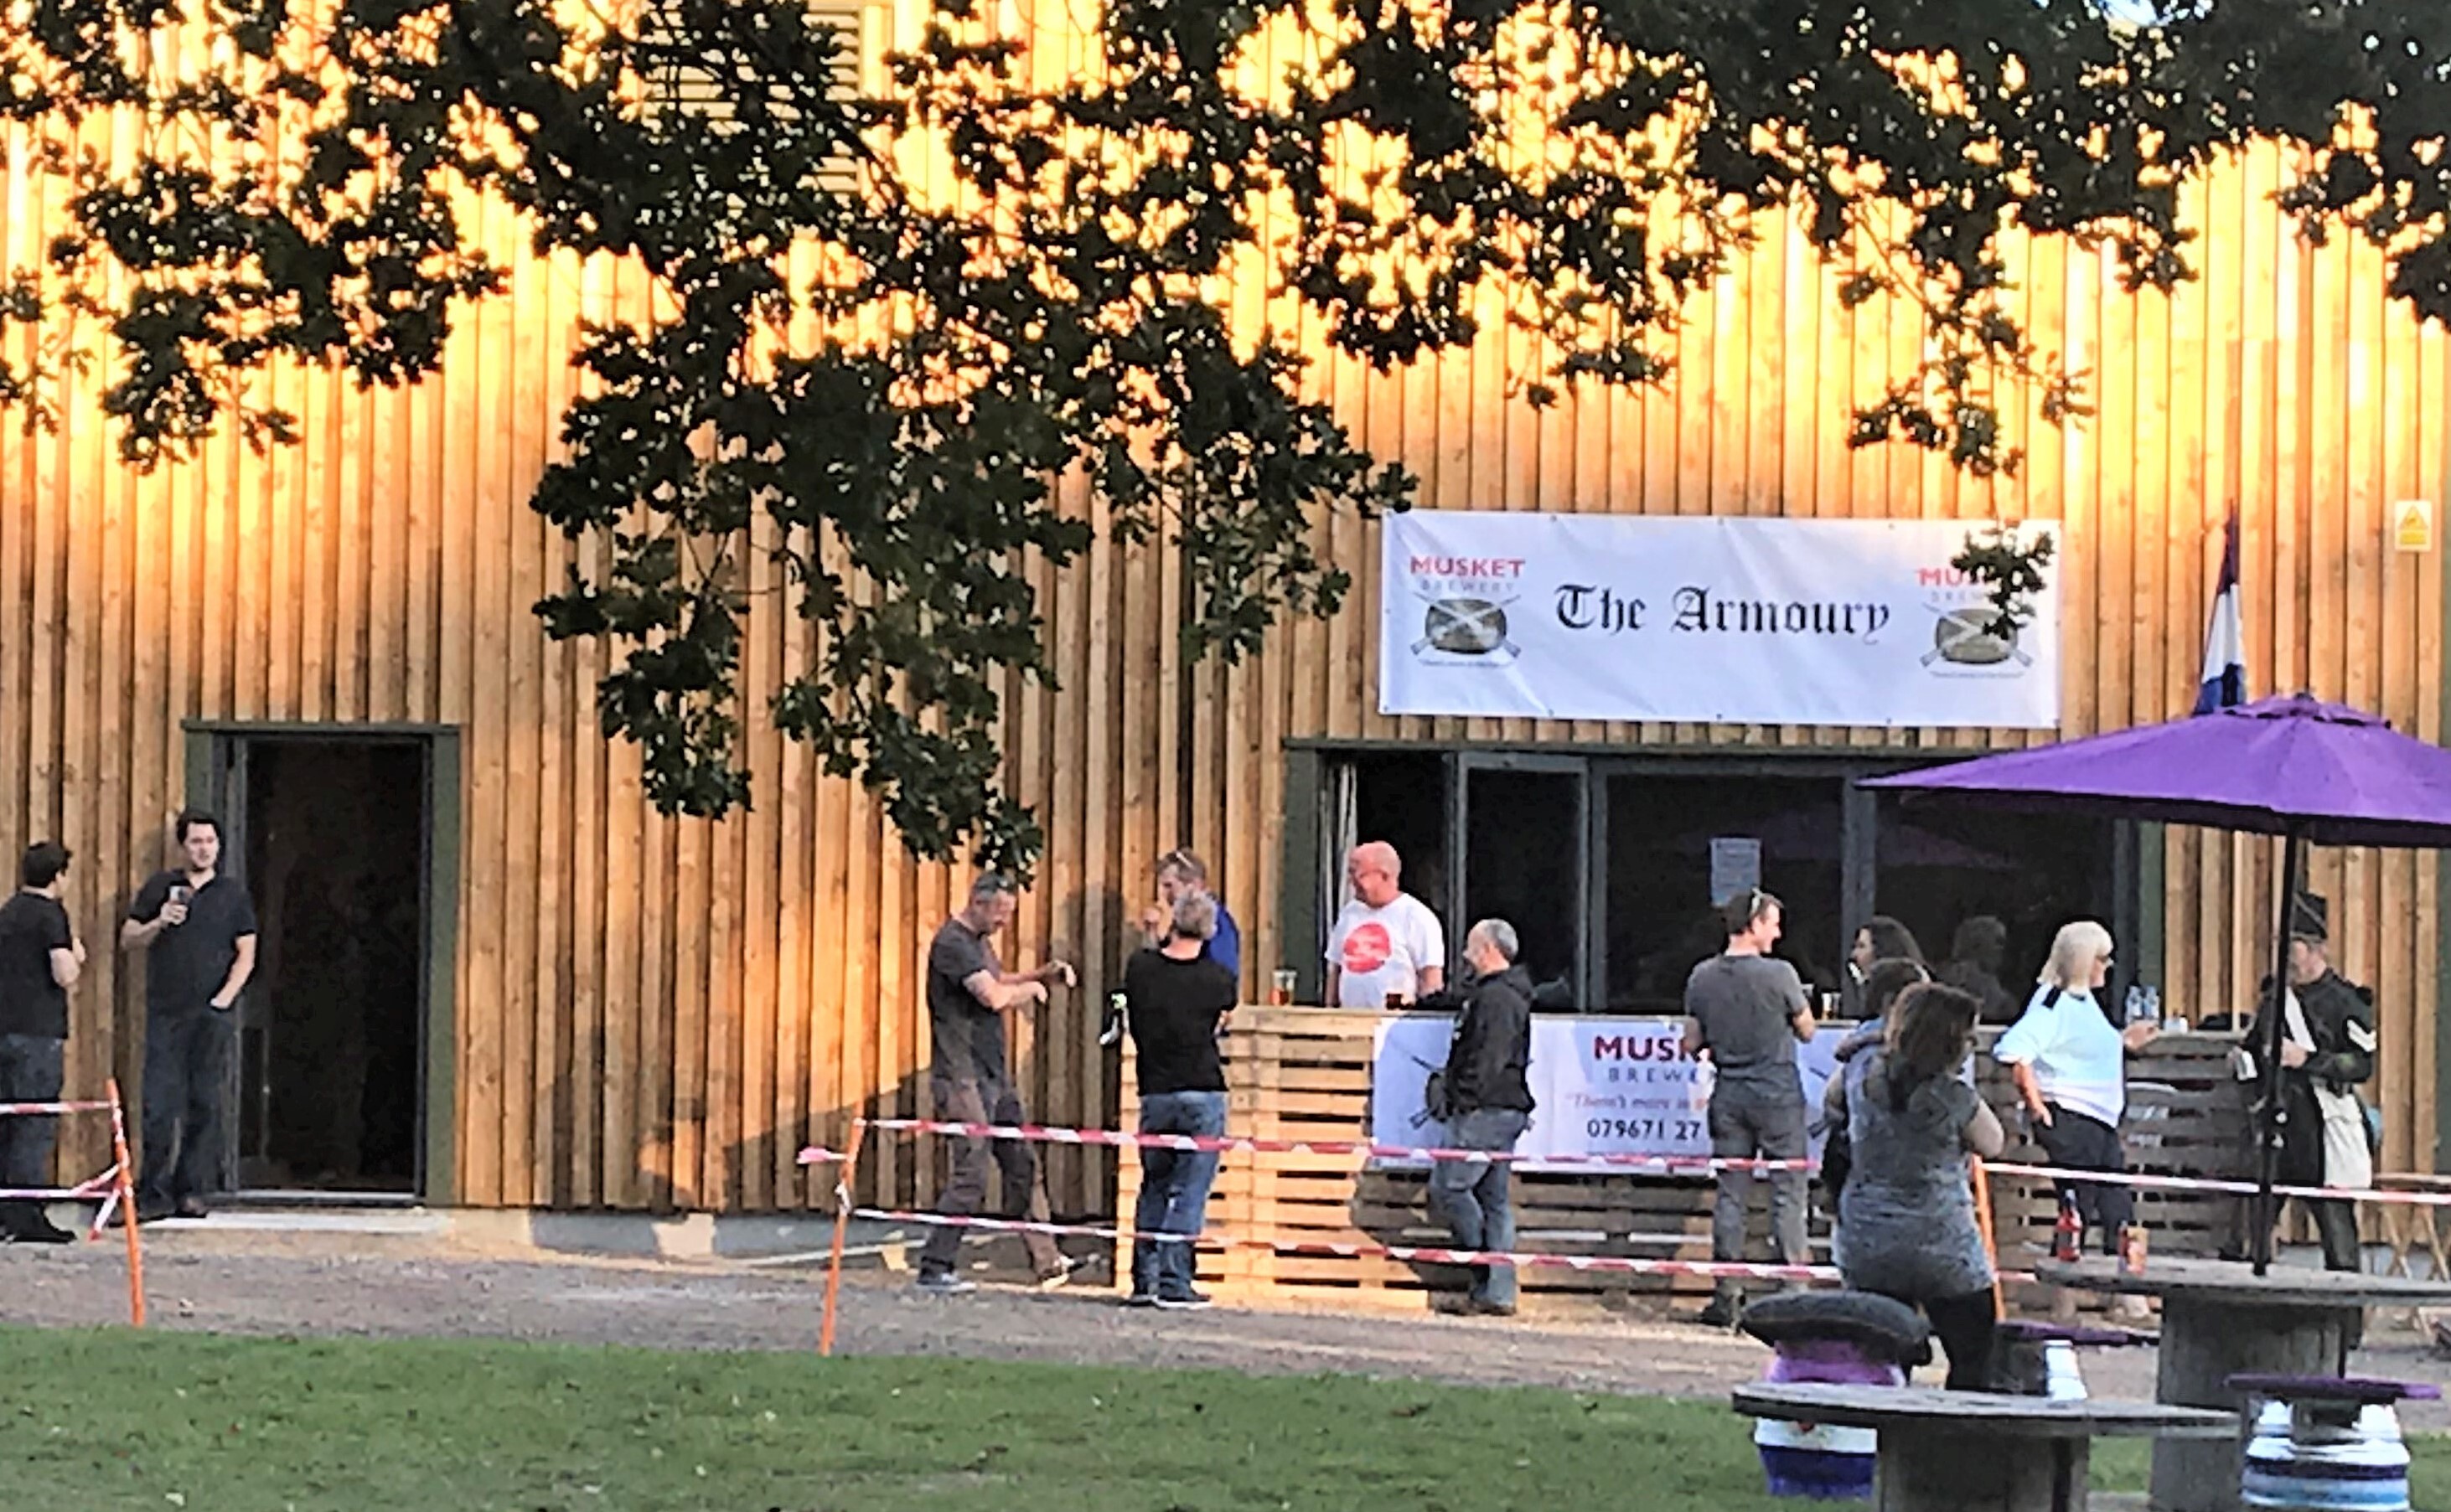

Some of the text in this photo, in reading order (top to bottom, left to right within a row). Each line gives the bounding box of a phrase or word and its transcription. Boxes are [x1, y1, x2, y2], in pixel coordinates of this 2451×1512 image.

[1409, 555, 1526, 578] MUSKET
[1554, 584, 1890, 645] The Armoury
[1594, 1035, 1699, 1061] MUSK
[1586, 1118, 1664, 1140] 079671
